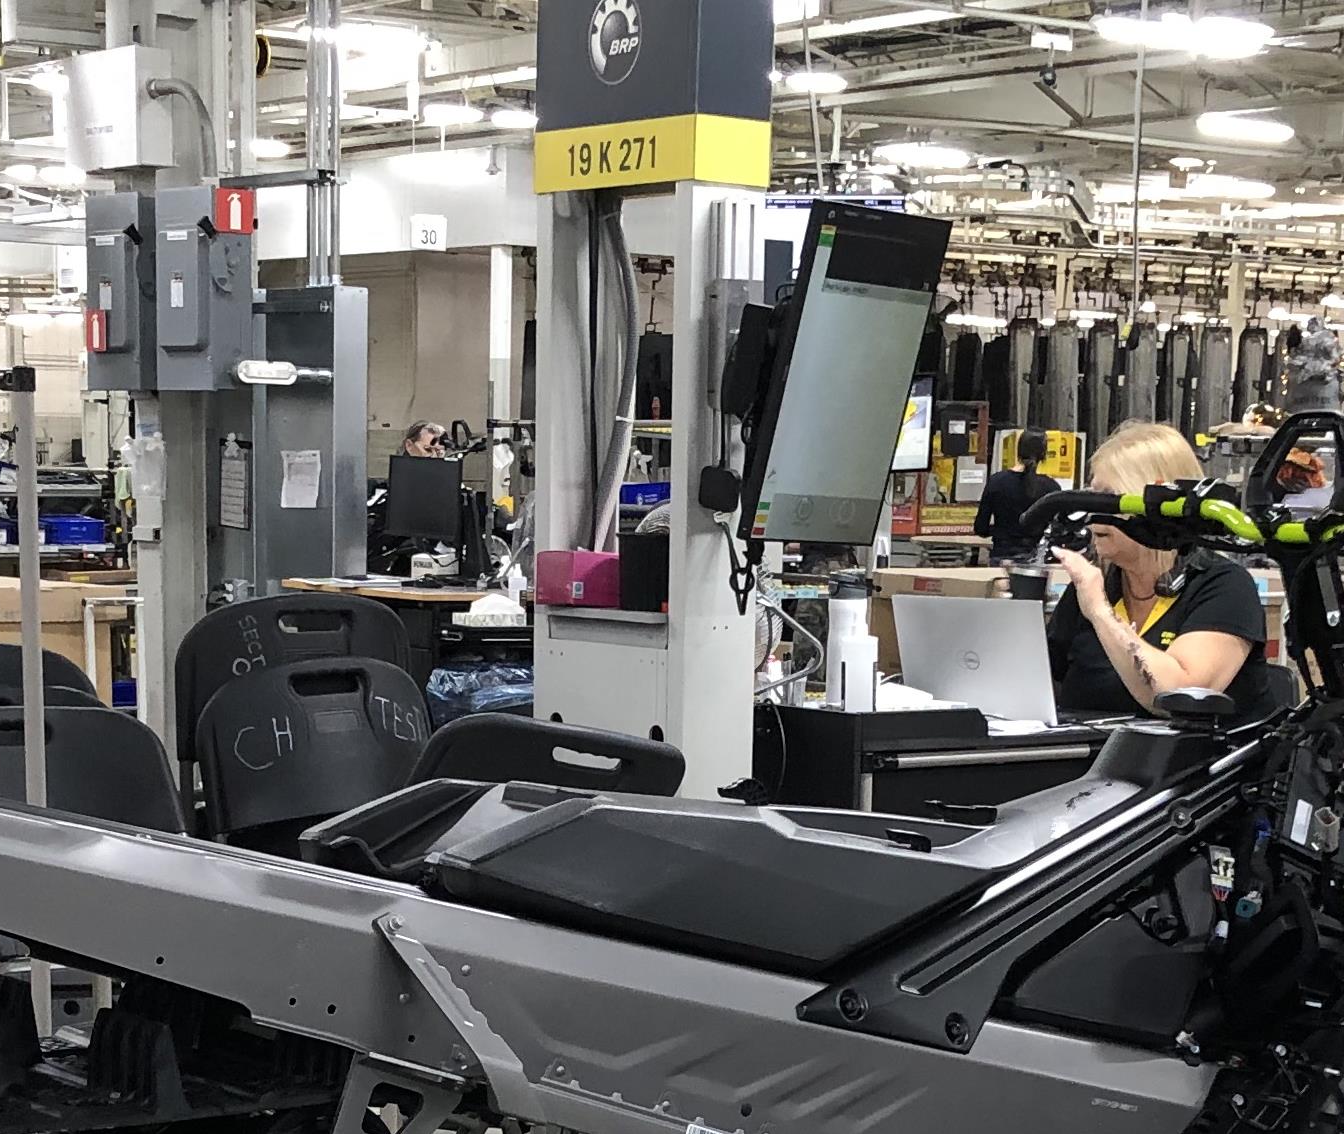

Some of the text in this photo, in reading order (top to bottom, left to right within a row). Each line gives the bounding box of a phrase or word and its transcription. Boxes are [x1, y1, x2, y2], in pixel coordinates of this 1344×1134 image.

[609, 36, 639, 56] BRP
[568, 136, 656, 176] 19 K 271
[421, 229, 437, 245] 30
[234, 715, 294, 771] CH
